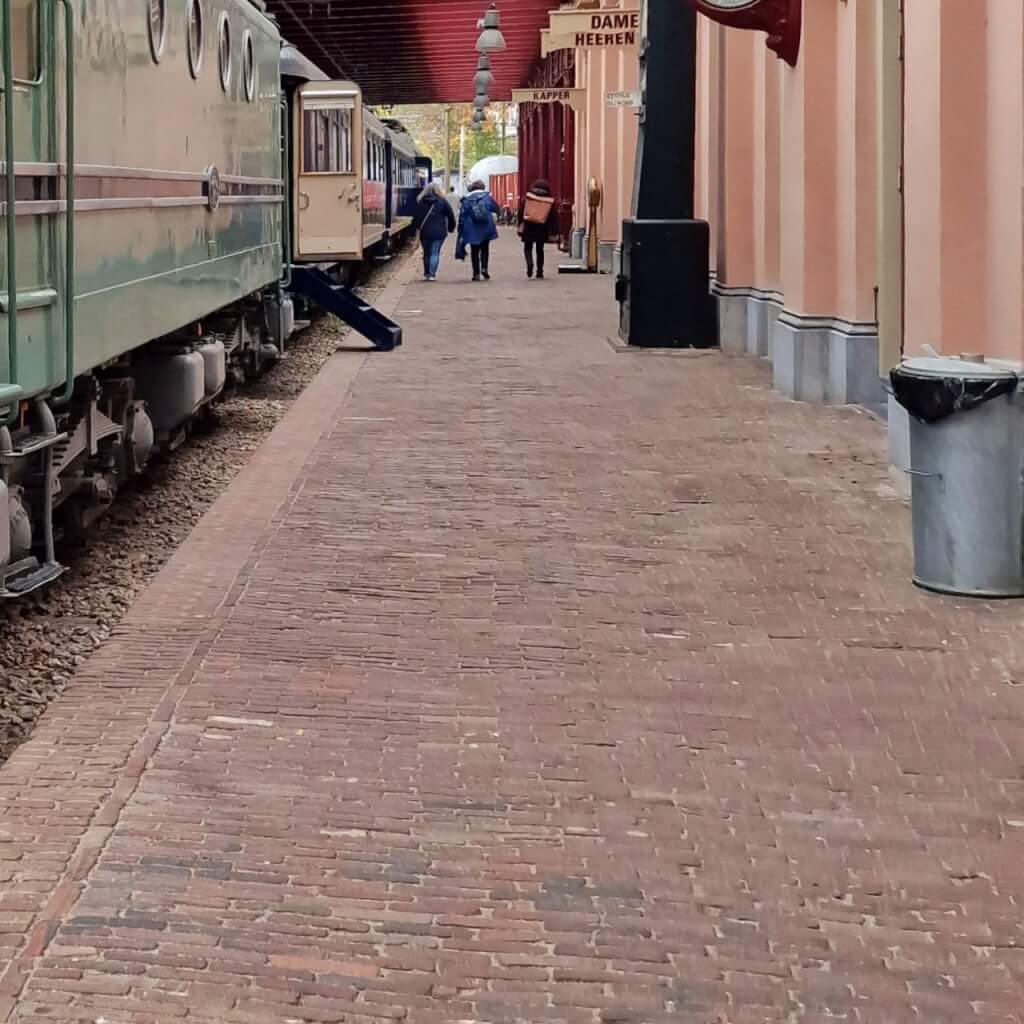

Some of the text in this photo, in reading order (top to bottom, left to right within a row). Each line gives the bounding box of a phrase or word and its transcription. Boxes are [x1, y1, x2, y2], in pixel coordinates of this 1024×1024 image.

[591, 14, 639, 29] DAME
[575, 31, 635, 46] HEEREN
[532, 90, 571, 100] KAPPER
